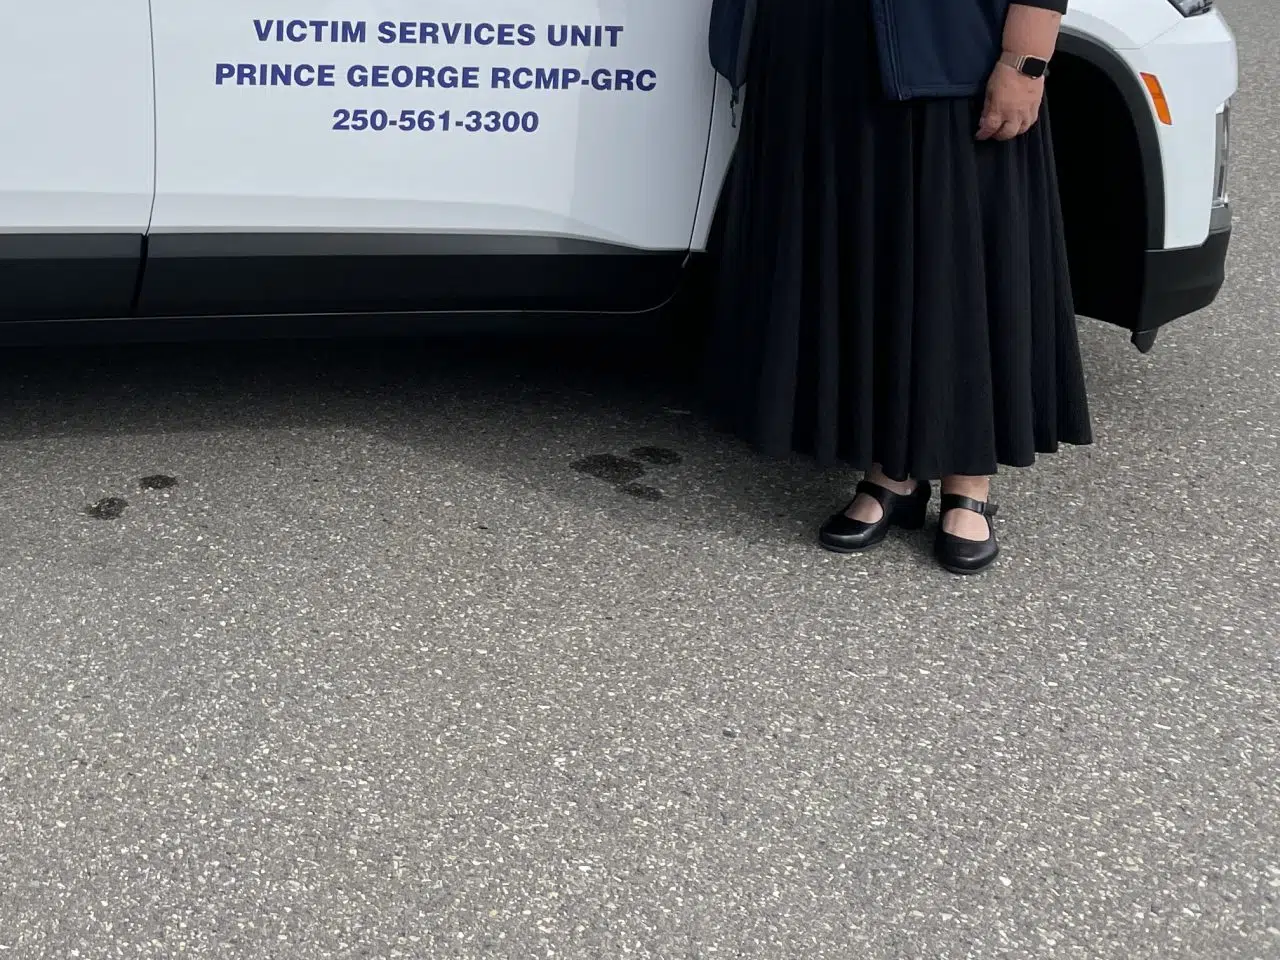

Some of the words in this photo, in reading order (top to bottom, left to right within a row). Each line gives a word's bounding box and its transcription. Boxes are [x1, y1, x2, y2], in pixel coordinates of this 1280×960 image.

[253, 20, 366, 43] VICTIM
[378, 21, 536, 46] SERVICES
[548, 25, 624, 47] UNIT
[215, 63, 336, 87] PRINCE
[347, 65, 480, 89] GEORGE
[491, 67, 657, 92] RCMP-GRC
[332, 109, 539, 133] 250-561-3300
